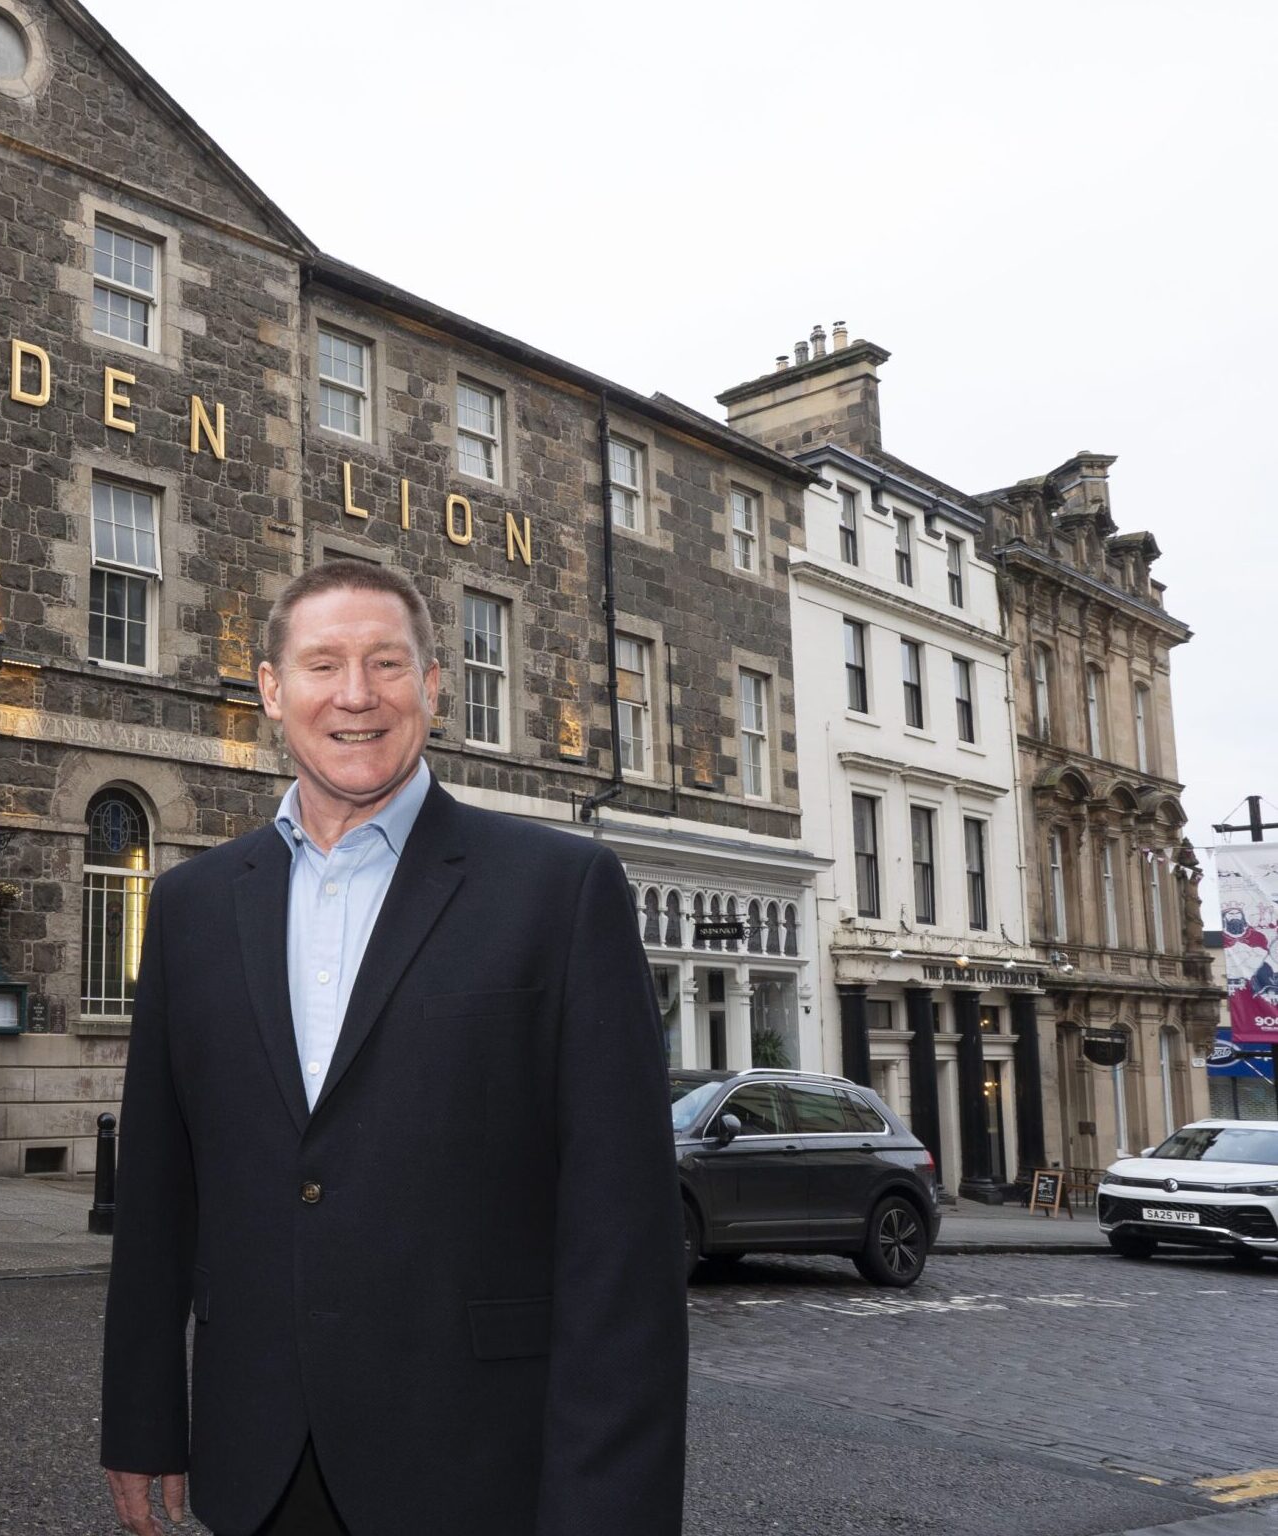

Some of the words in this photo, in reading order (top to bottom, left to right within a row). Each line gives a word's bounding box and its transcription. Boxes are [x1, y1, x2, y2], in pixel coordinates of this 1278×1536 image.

[342, 461, 533, 567] LION
[1254, 1016, 1278, 1027] 90
[1146, 1209, 1173, 1220] SA25
[1175, 1211, 1195, 1222] VFP
